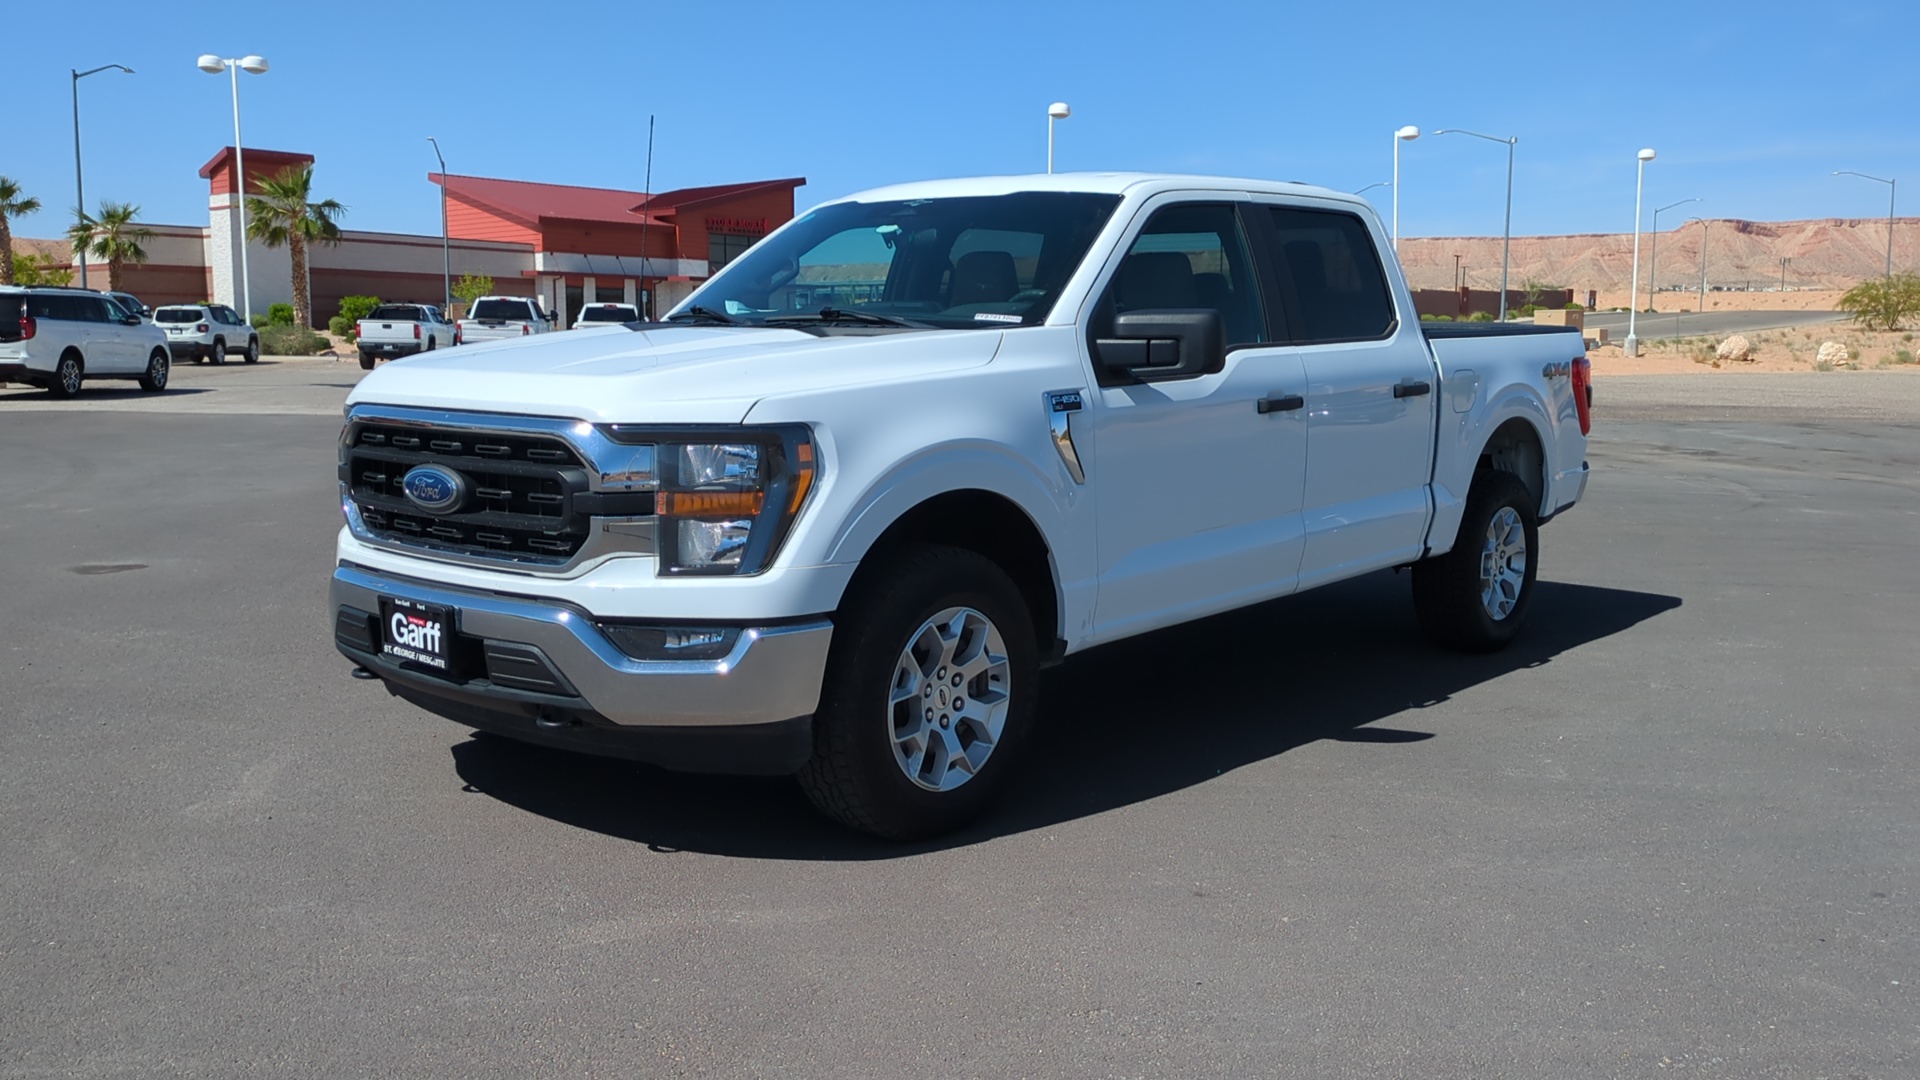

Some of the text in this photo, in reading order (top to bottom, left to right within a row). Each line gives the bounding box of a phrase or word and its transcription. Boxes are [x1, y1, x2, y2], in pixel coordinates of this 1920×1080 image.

[1052, 395, 1080, 404] F-150
[413, 476, 441, 499] Ford
[391, 612, 441, 653] Garff
